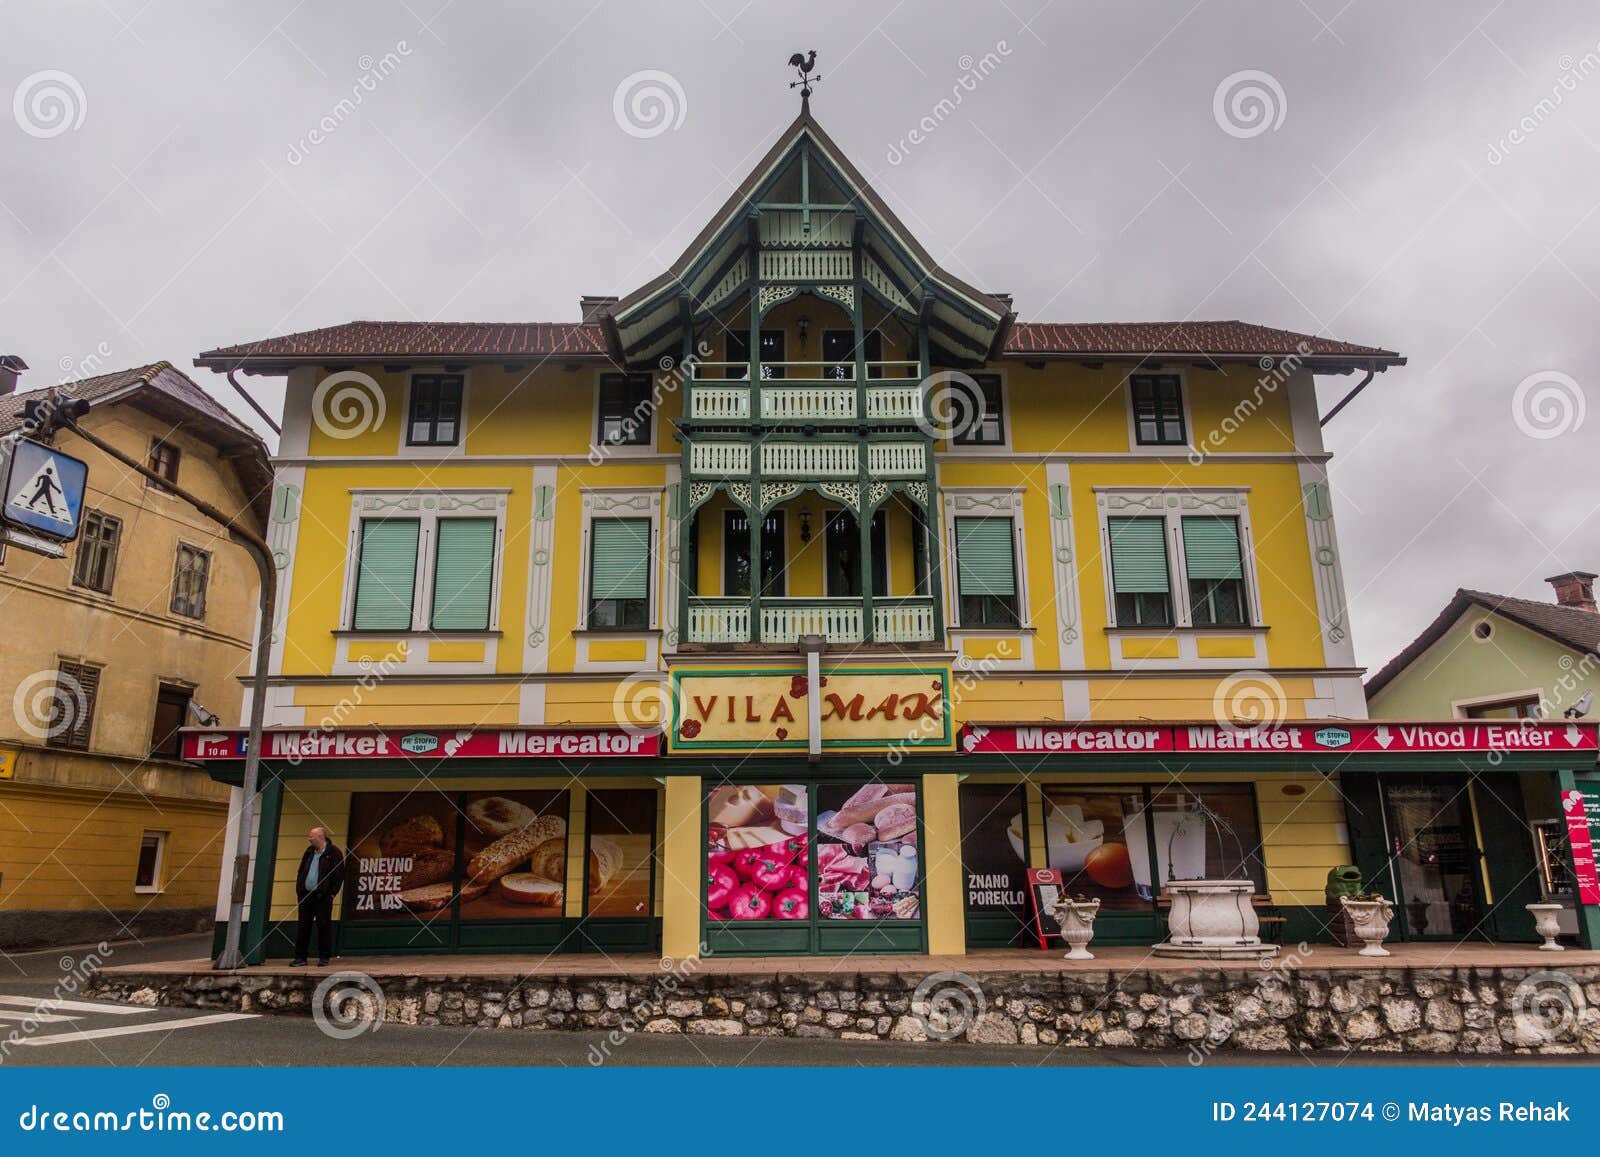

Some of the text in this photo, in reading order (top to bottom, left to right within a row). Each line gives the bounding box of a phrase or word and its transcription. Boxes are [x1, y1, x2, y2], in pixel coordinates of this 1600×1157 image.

[692, 693, 944, 722] VILA MAK
[272, 733, 388, 755] Market
[498, 732, 645, 753] Mercator
[1015, 727, 1160, 749] Mercator
[1187, 727, 1303, 749] Market
[1400, 726, 1467, 747] Vhod
[1487, 726, 1553, 747] Enter
[208, 747, 219, 756] 10
[360, 858, 413, 872] DNEVNO
[358, 873, 401, 891] SVEŽE
[968, 874, 1009, 889] ZNANO
[356, 894, 402, 910] ZA VAS
[969, 890, 1024, 905] POREKLO
